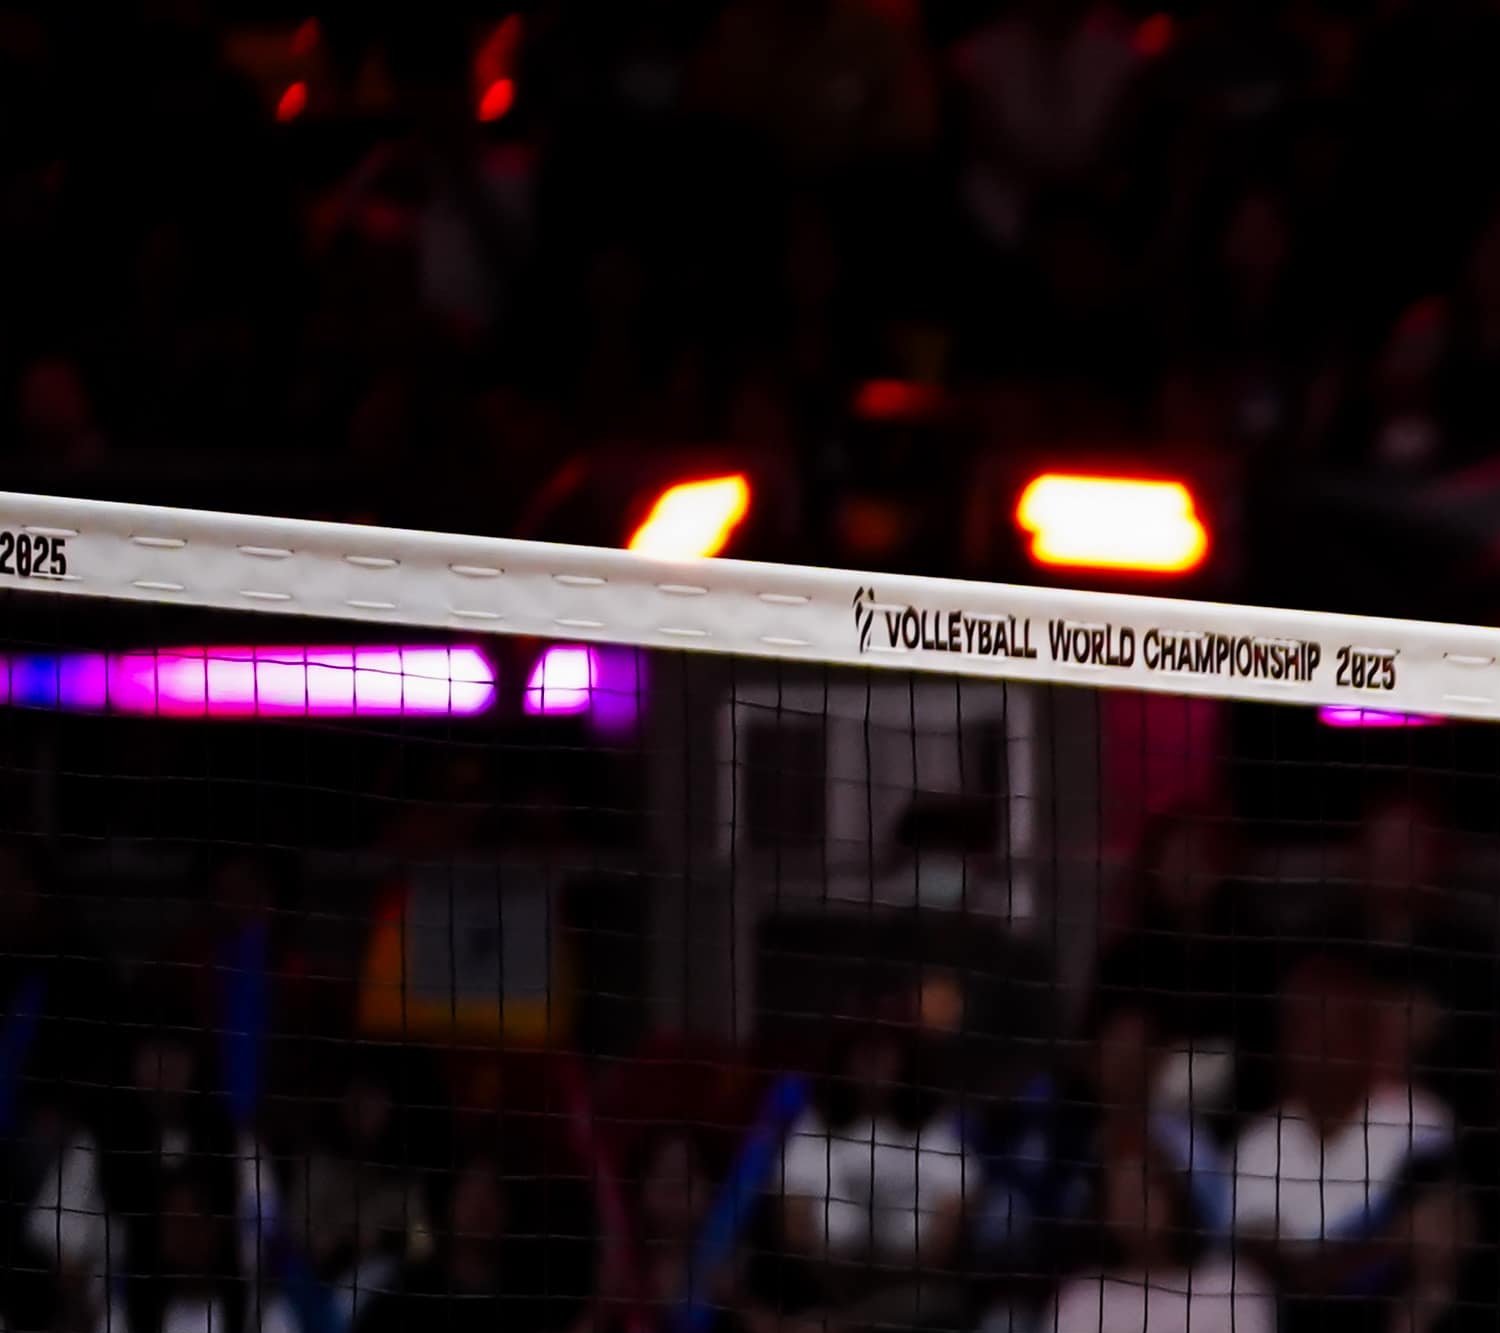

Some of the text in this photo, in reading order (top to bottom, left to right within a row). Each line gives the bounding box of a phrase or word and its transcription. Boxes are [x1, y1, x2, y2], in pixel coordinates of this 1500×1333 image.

[0, 531, 67, 577] 2025
[885, 606, 1397, 691] VOLLEYBALL WORLD CHAMPIONSHIP 2025
